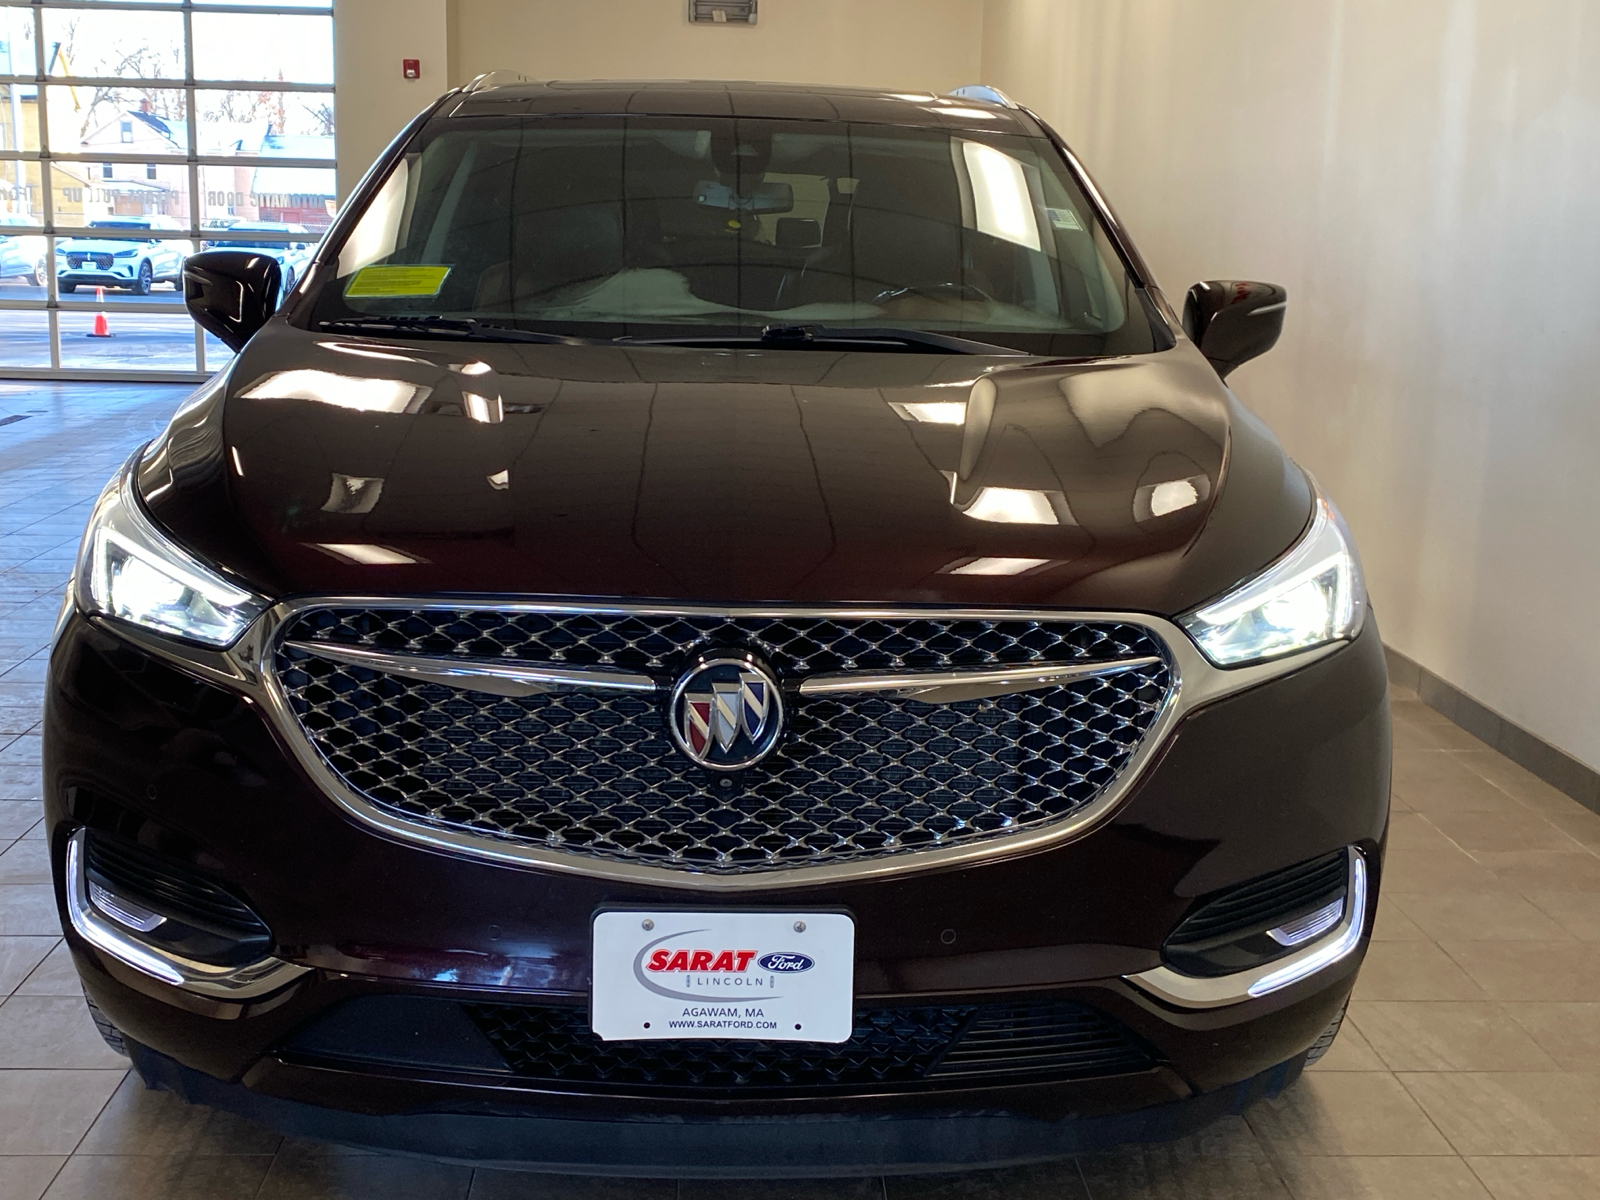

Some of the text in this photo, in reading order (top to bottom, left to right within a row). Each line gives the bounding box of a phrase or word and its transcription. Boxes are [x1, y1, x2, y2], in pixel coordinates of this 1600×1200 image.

[645, 948, 805, 974] SARAT Ford
[696, 977, 764, 987] LINCOLN
[681, 1007, 765, 1019] AGAWAM, MA
[668, 1020, 778, 1030] WWW.SARATFORD.COM
